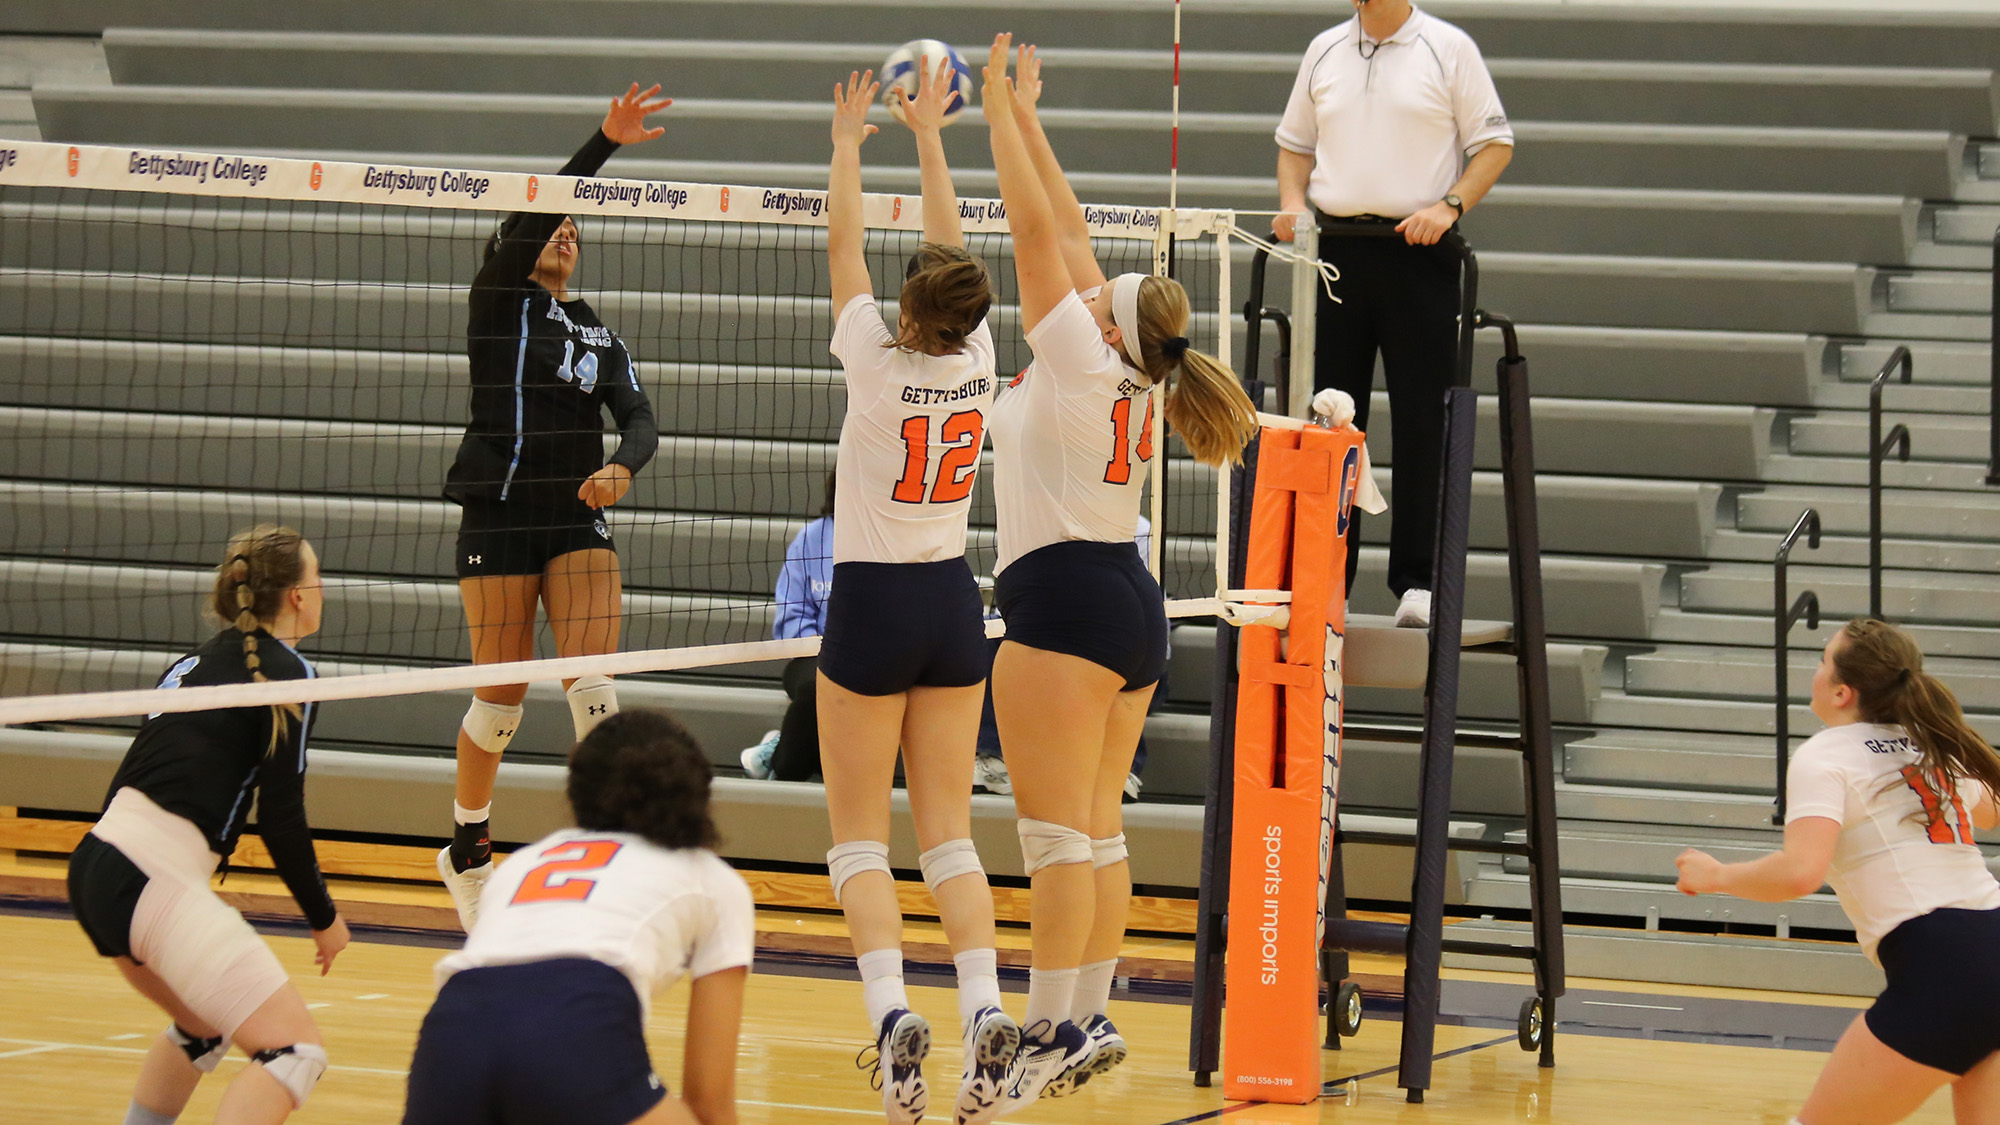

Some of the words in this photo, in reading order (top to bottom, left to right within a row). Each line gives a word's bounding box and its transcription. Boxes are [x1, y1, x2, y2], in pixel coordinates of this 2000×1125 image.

[128, 151, 208, 184] Gettysburg
[212, 156, 268, 187] College
[364, 166, 436, 197] Gettysburg
[440, 170, 490, 199] College
[574, 178, 642, 207] Gettysburg
[645, 183, 688, 210] College
[762, 189, 823, 217] Gettysburg
[557, 339, 598, 394] 14
[891, 408, 984, 504] 12
[507, 839, 624, 908] 2
[1262, 825, 1282, 895] sports
[1259, 899, 1279, 985] imports
[1237, 1075, 1257, 1085] (800)
